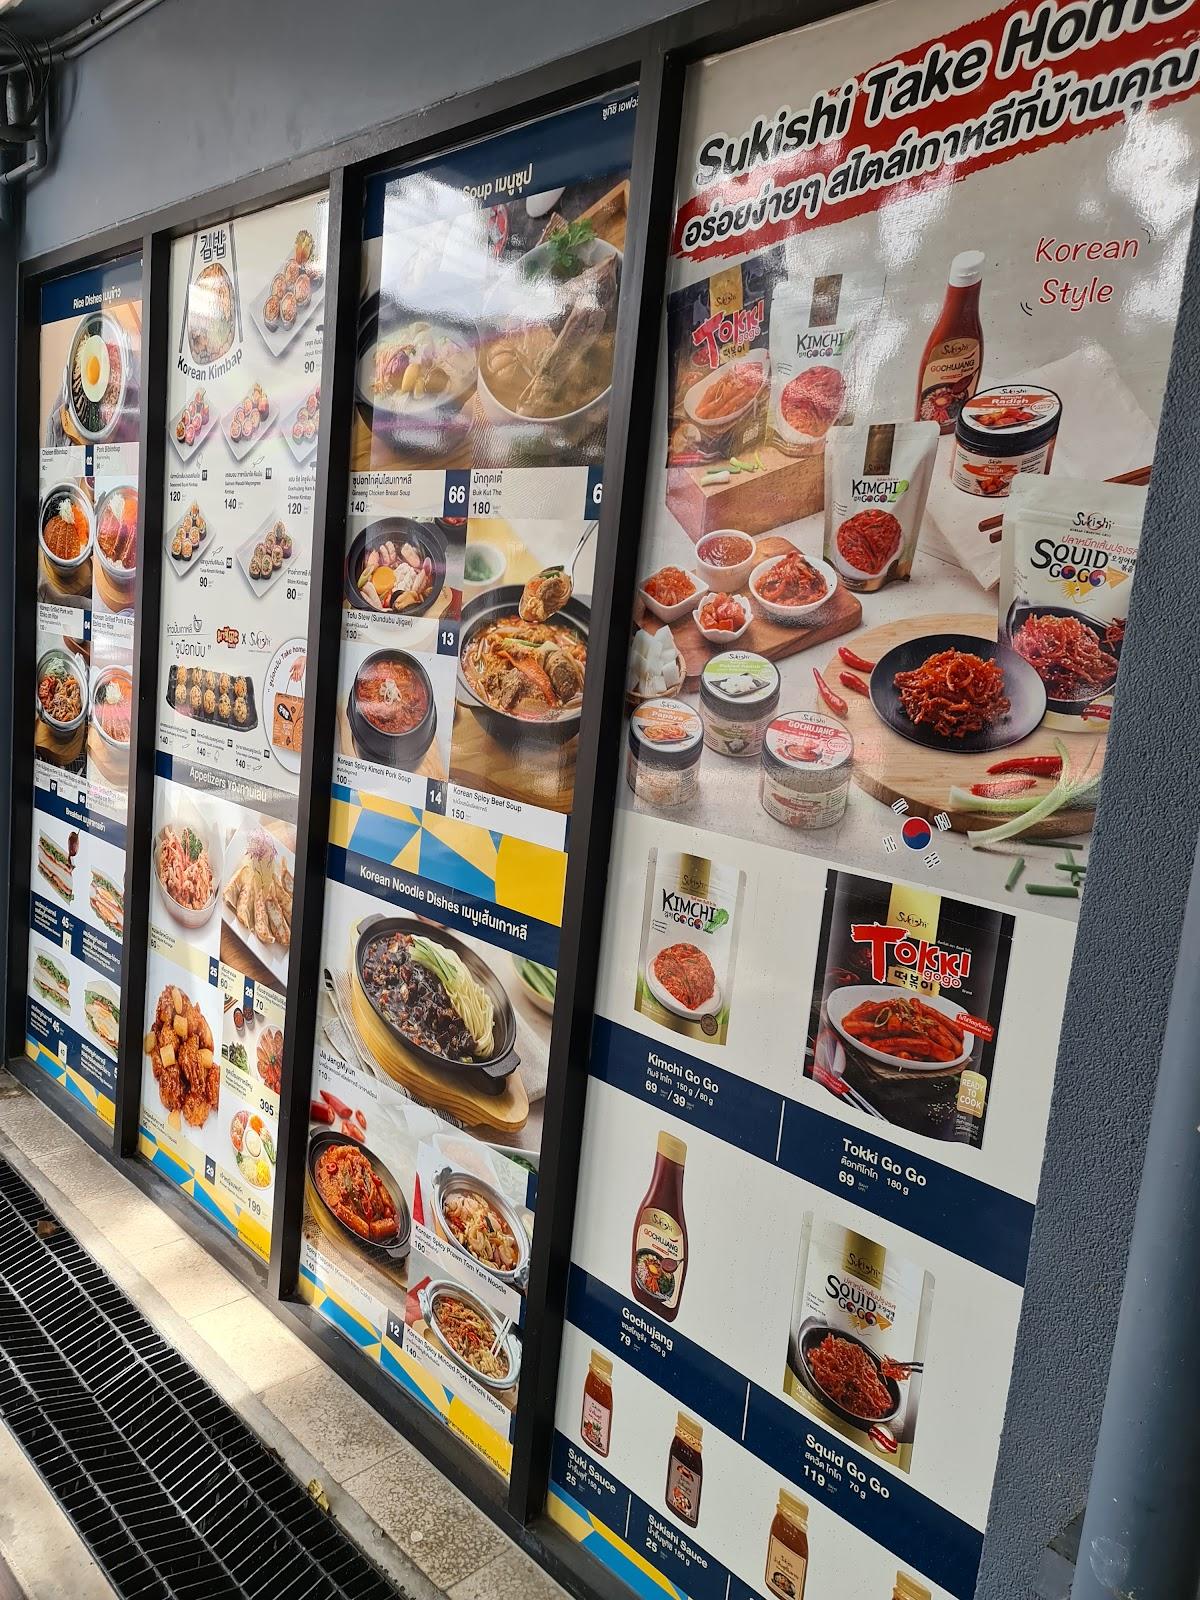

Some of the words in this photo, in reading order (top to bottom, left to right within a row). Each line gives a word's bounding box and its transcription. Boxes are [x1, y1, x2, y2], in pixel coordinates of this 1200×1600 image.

[698, 85, 856, 186] Sukishi
[863, 45, 986, 124] Take
[685, 180, 821, 247] อร่อยง่ายๆ
[829, 48, 1196, 202] สไตล์เกาหลีที่บ้านคุณ
[463, 182, 491, 201] Soup
[200, 229, 226, 262] 김밥
[1035, 236, 1138, 263] Korean
[73, 296, 84, 310] Rice
[85, 292, 103, 307] Dishes
[1040, 277, 1113, 312] Style
[797, 332, 845, 353] KIMCHI
[177, 355, 206, 381] Korean
[208, 348, 243, 380] Kimbap
[304, 360, 316, 374] 90
[930, 359, 975, 373] GOCHUJANG
[170, 491, 181, 502] 120
[449, 485, 466, 504] 66
[852, 479, 898, 497] KIMCHI
[224, 498, 237, 509] 140
[288, 502, 302, 514] 120
[350, 501, 365, 513] 140
[472, 501, 491, 514] 180
[1072, 511, 1114, 530] Sukishi
[1031, 538, 1109, 569] SQUID
[199, 576, 208, 588] 90
[286, 588, 297, 600] 80
[441, 631, 455, 646] 13
[652, 711, 684, 721] Papaya
[788, 720, 834, 735] GOCHUJANG
[159, 735, 169, 745] 140
[235, 758, 246, 769] 140
[337, 756, 354, 767] Korean
[354, 761, 368, 773] Spicy
[368, 766, 385, 776] Kimchi
[385, 769, 397, 779] Pork
[397, 773, 412, 784] Soup
[189, 766, 226, 788] Appetizers
[336, 774, 348, 785] 100
[429, 789, 442, 805] 14
[453, 786, 473, 798] Korean
[474, 792, 491, 805] Spicy
[491, 797, 505, 807] Beef
[505, 801, 522, 813] Soup
[451, 808, 465, 820] 150
[360, 864, 391, 888] Korean
[392, 877, 425, 900] Noodle
[426, 890, 460, 914] Dishes
[461, 904, 528, 941] เมนูเส้นเกาหลี
[662, 888, 716, 922] KIMCHI
[62, 915, 70, 929] 45
[896, 911, 928, 928] Sukishi
[923, 969, 961, 988] gogo
[256, 999, 264, 1011] 70
[318, 1069, 328, 1080] 110
[648, 1052, 683, 1077] Kimchi
[685, 1069, 701, 1085] Go
[702, 1077, 719, 1093] Go
[645, 1080, 658, 1093] 69
[672, 1093, 686, 1107] 39
[676, 1082, 688, 1093] 150
[961, 1079, 986, 1093] READY
[967, 1089, 977, 1098] TO
[260, 1098, 274, 1116] 395
[959, 1095, 982, 1109] COOK
[206, 1164, 215, 1178] 29
[842, 1138, 879, 1165] Tokki
[881, 1156, 902, 1175] Go
[905, 1167, 927, 1186] Go
[838, 1170, 855, 1187] 69
[886, 1177, 902, 1191] 180
[902, 1187, 909, 1196] g
[247, 1197, 261, 1216] 199
[414, 1240, 426, 1253] 160
[415, 1224, 432, 1239] Korean
[432, 1236, 446, 1252] Spicy
[446, 1247, 463, 1264] Prawn
[463, 1259, 475, 1271] Tom
[643, 1228, 679, 1253] GOCHUJANG
[825, 1274, 876, 1312] SQUID
[389, 1320, 400, 1338] 12
[622, 1307, 673, 1351] Gochujang
[620, 1331, 631, 1346] 79
[650, 1341, 662, 1352] 250
[405, 1344, 417, 1358] 140
[406, 1328, 424, 1345] Korean
[424, 1339, 437, 1358] Spicy
[437, 1351, 456, 1373] Minced
[456, 1367, 468, 1383] Pork
[468, 1378, 486, 1398] Kimchi
[486, 1394, 506, 1415] Noodle
[568, 1447, 587, 1470] Suki
[588, 1464, 617, 1494] Sauce
[806, 1433, 844, 1468] Squid
[847, 1461, 867, 1483] Go
[869, 1477, 890, 1498] Go
[565, 1471, 577, 1486] 25
[587, 1478, 598, 1490] 150
[803, 1465, 825, 1487] 119
[849, 1480, 859, 1493] 70
[860, 1490, 866, 1500] g
[645, 1537, 658, 1553] 25
[648, 1514, 679, 1545] Sukishi
[679, 1540, 708, 1569] Sauce
[674, 1548, 686, 1561] 150
